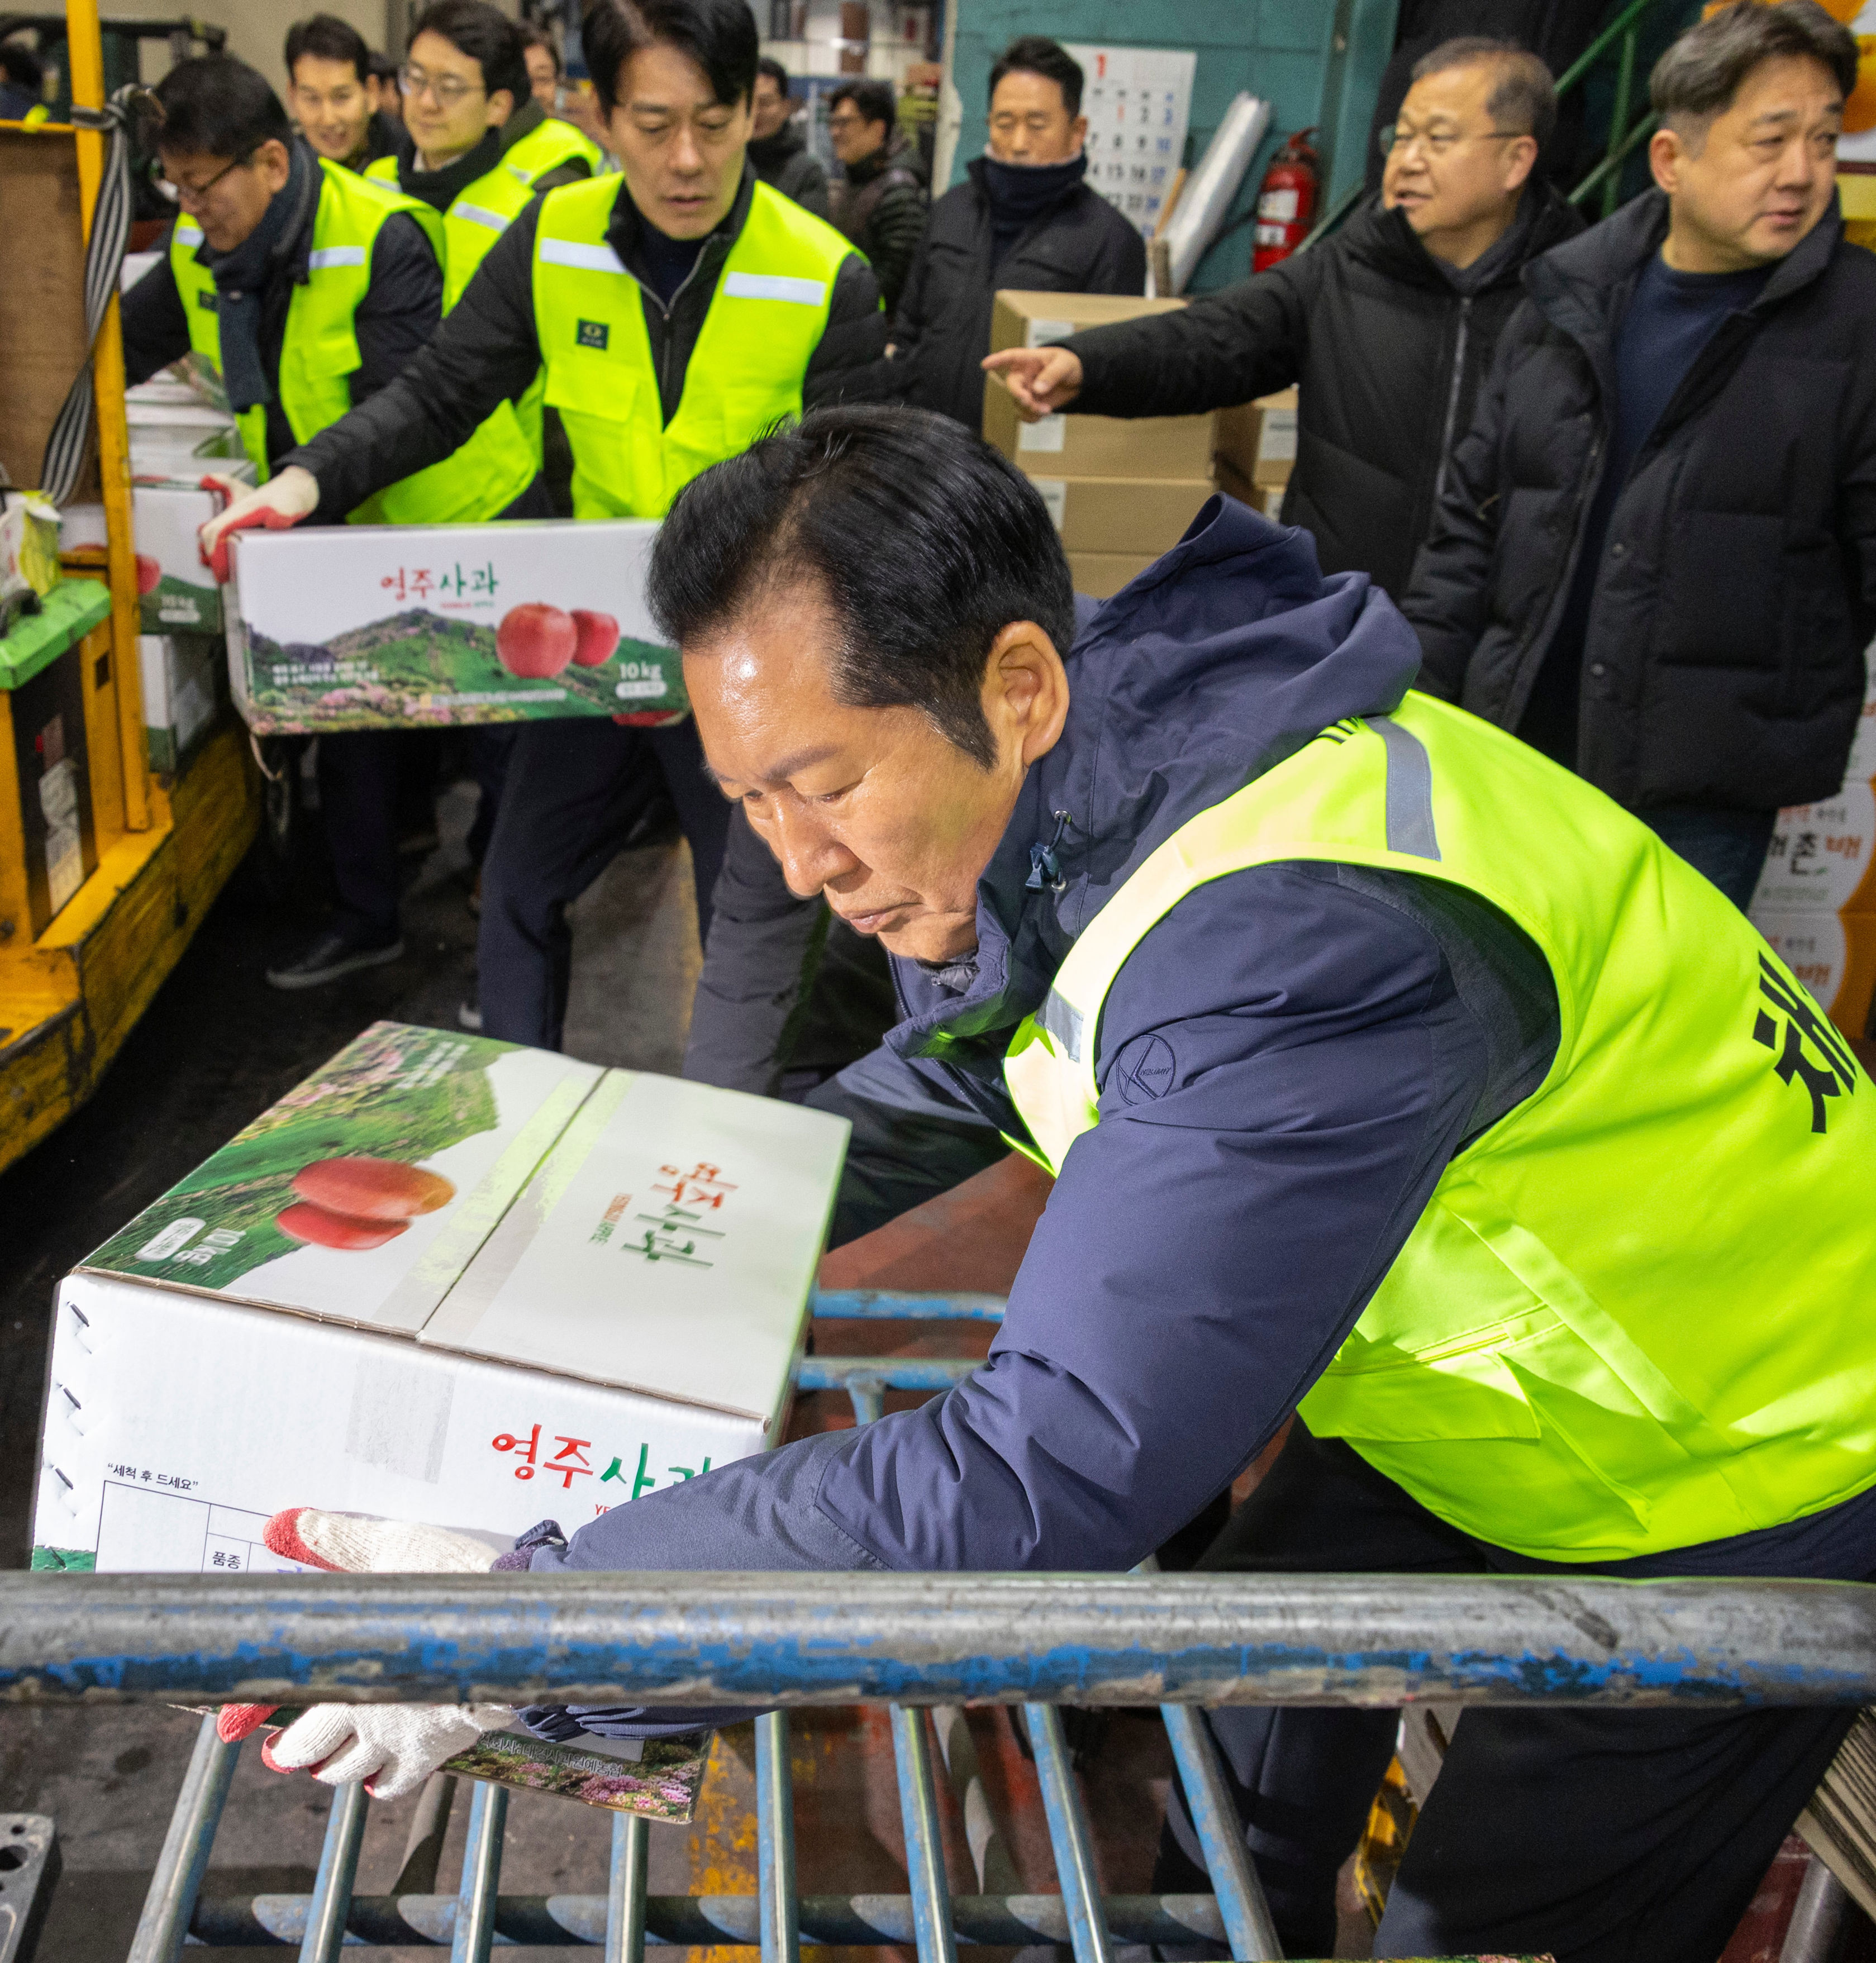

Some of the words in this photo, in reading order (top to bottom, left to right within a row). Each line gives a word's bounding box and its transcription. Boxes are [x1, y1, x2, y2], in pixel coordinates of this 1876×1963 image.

[381, 562, 498, 602] 영주사과
[140, 1470, 153, 1482] 후
[212, 1550, 241, 1570] 품종
